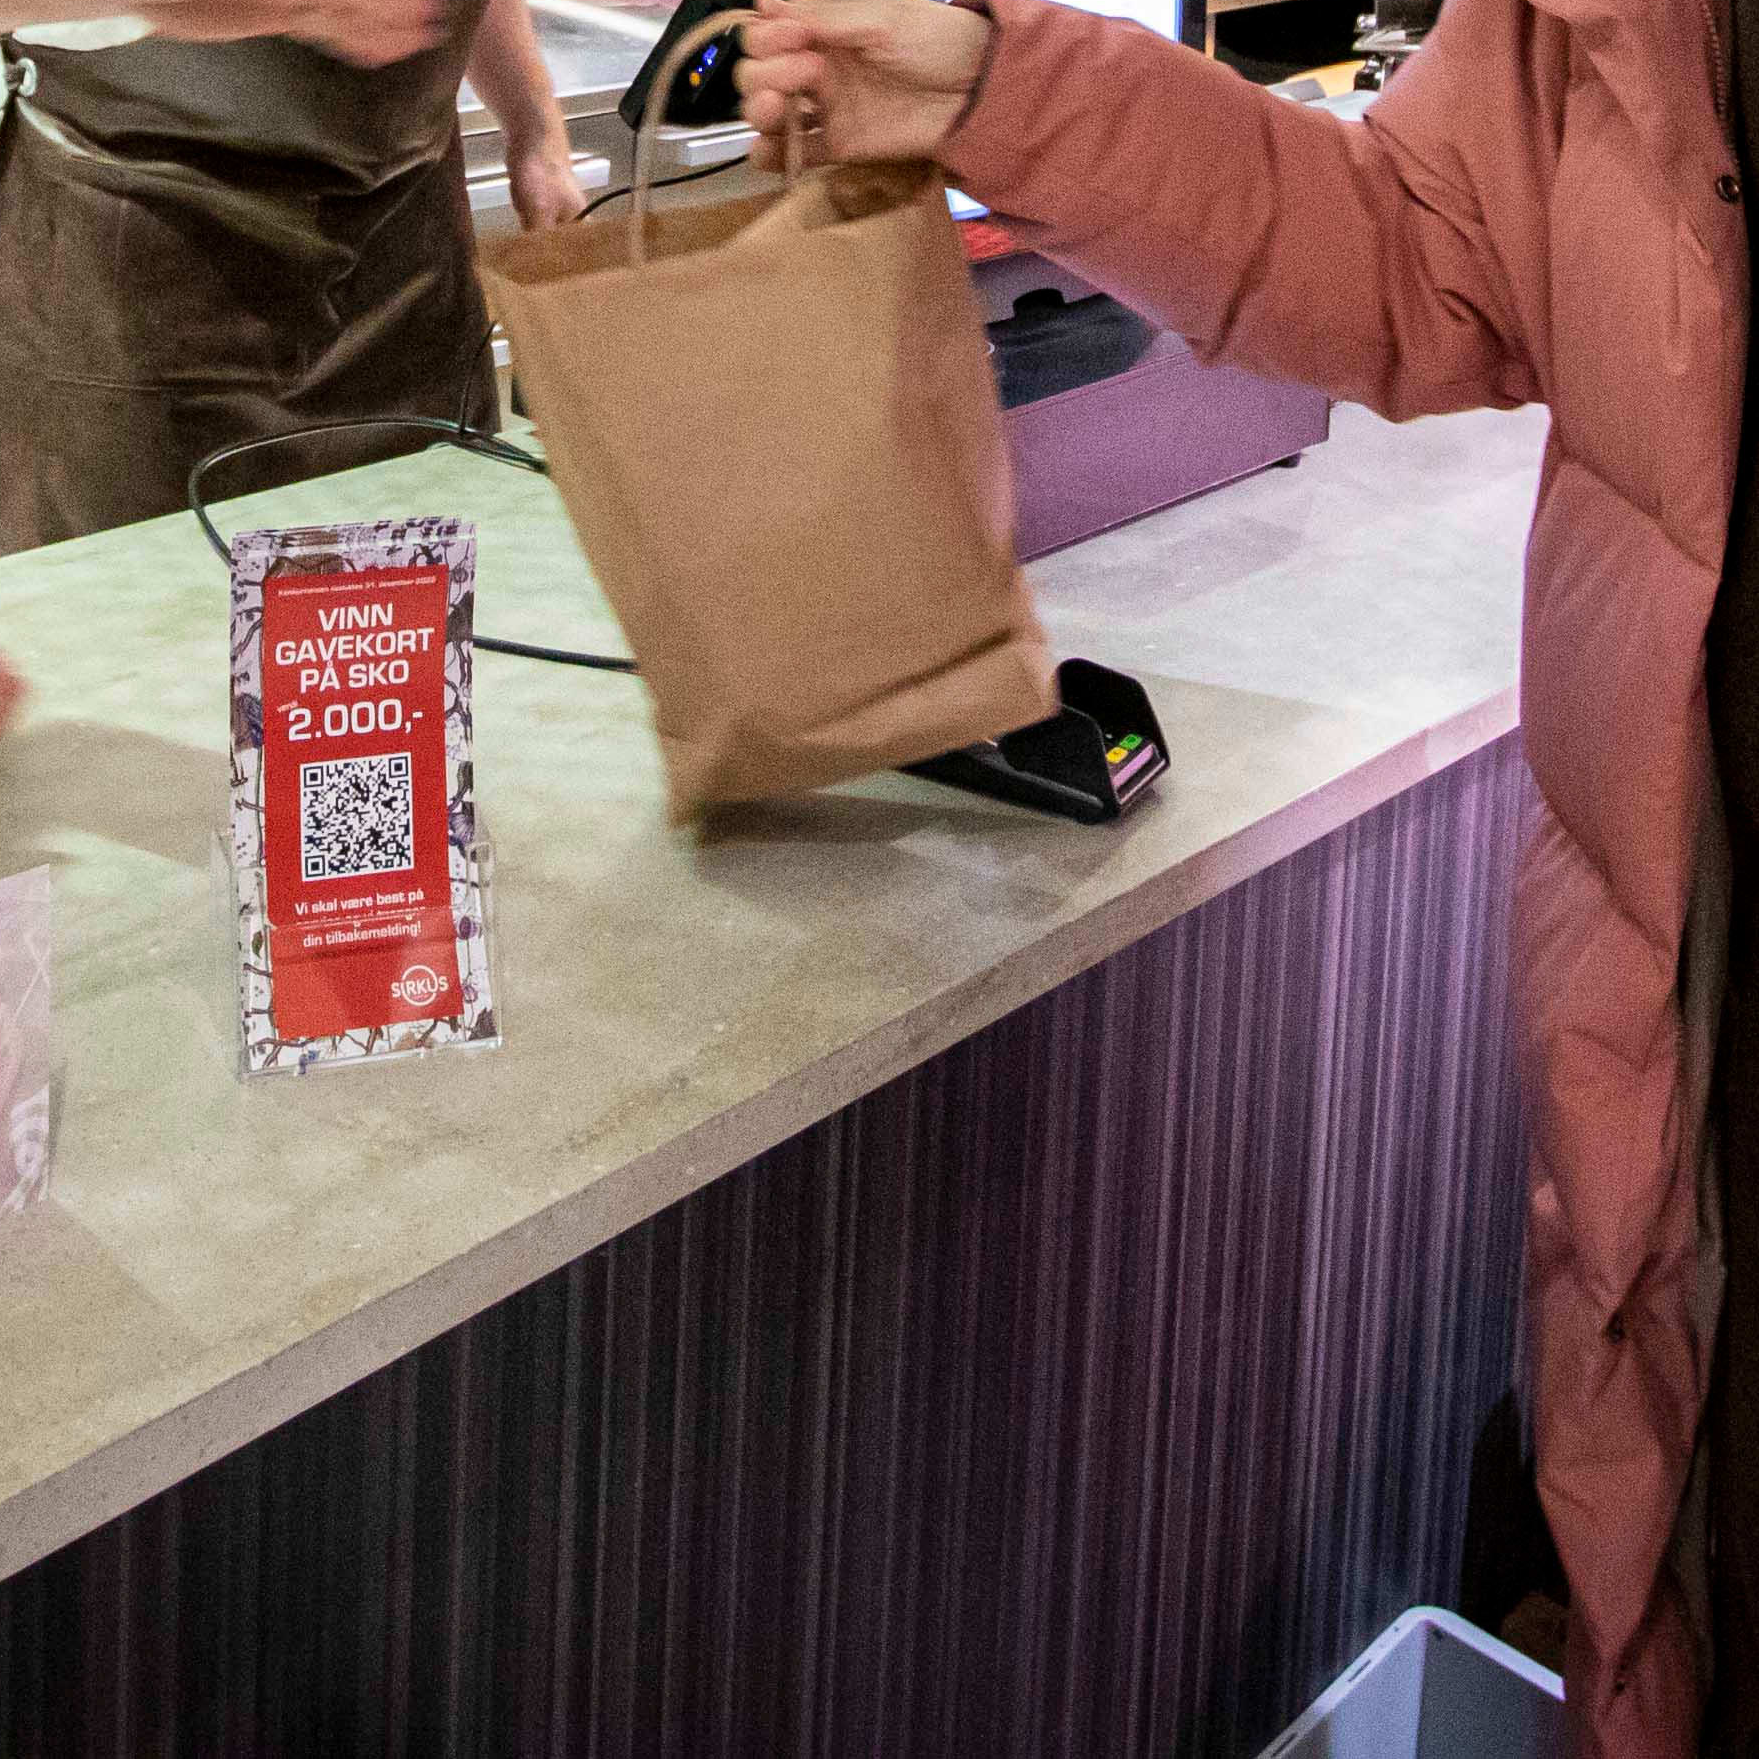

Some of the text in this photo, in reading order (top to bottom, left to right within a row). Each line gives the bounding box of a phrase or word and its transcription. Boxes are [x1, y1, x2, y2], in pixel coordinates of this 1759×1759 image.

[318, 603, 393, 632] VINN
[275, 627, 435, 666] GAVEKORT
[300, 659, 410, 694] PÅ SKO
[288, 698, 423, 742] 2.000,-
[294, 888, 425, 916] Vi skal være best på
[303, 921, 422, 948] din tilbakemelding!
